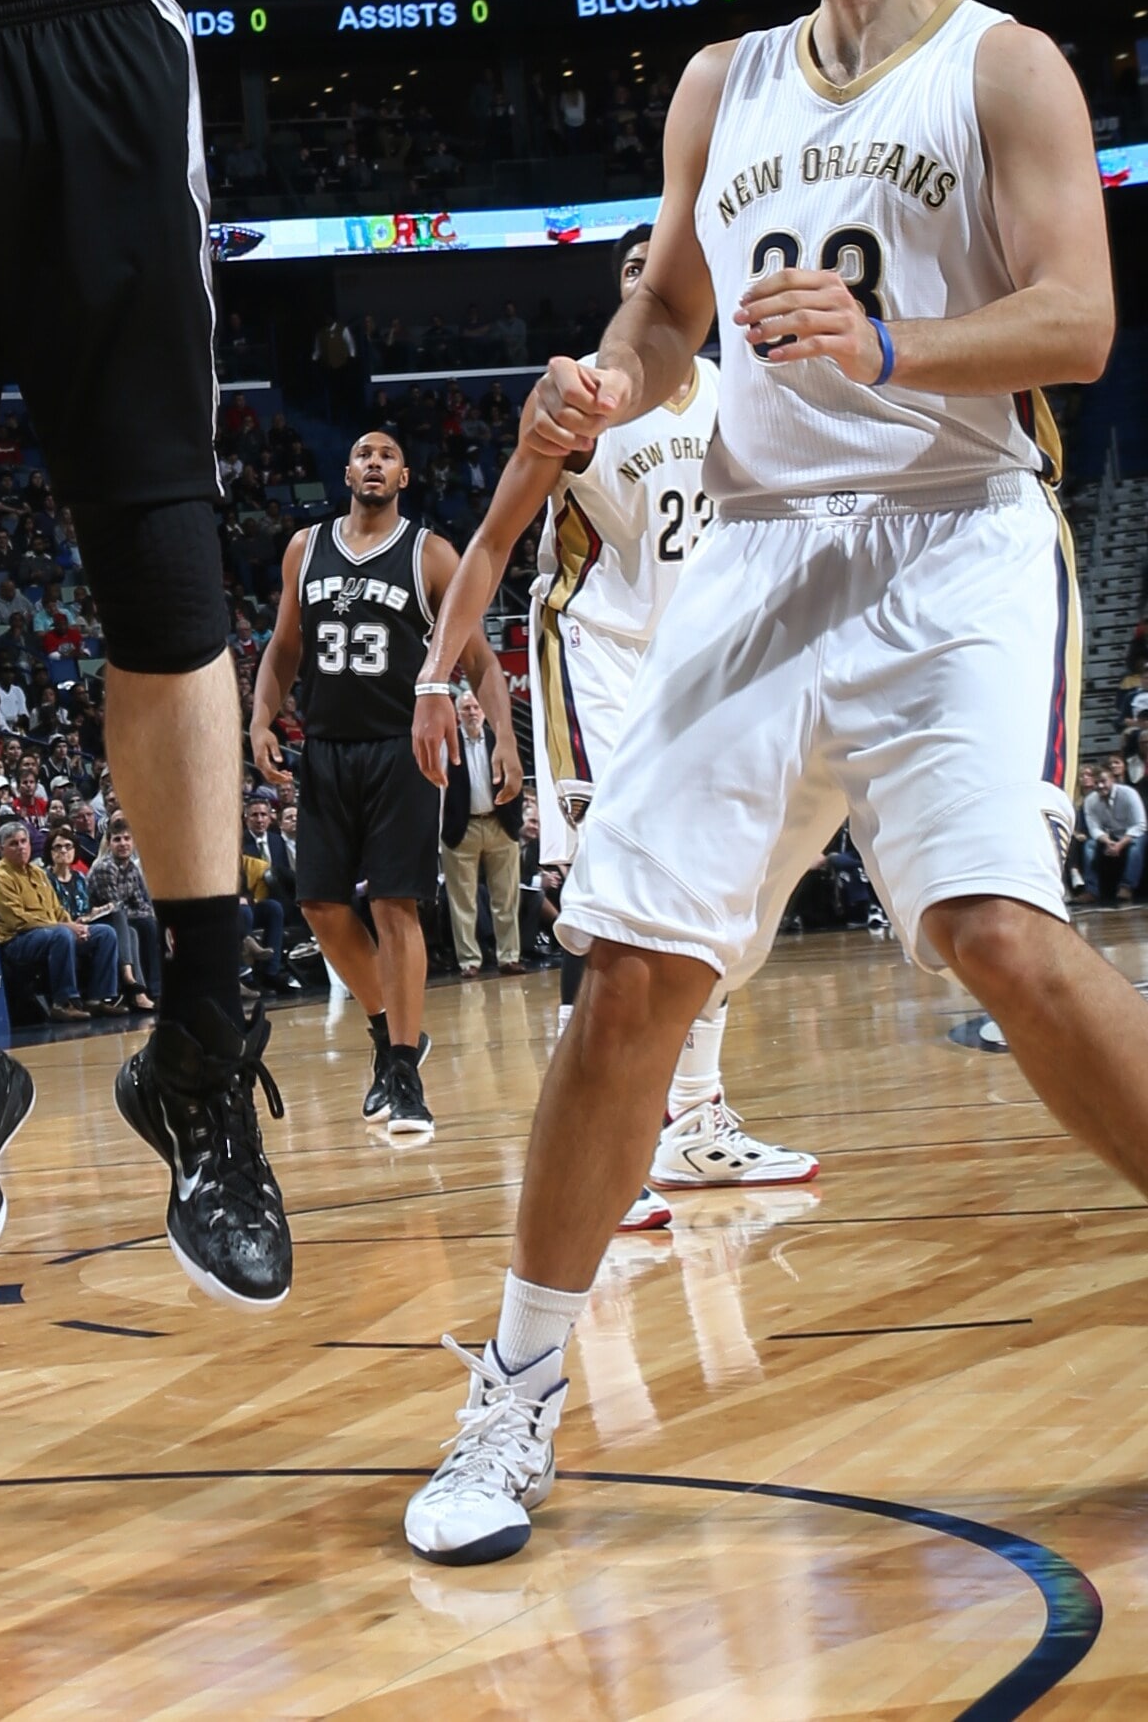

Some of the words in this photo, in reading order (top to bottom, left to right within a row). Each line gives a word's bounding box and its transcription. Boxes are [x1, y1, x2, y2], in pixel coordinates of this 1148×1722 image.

[250, 8, 267, 32] 0
[338, 2, 457, 30] ASSISTS
[471, 0, 489, 24] 0
[717, 150, 783, 229] NEW
[802, 141, 958, 212] ORLEANS
[618, 442, 665, 485] NEW
[670, 435, 713, 461] ORL
[305, 575, 411, 616] SPURS
[316, 620, 390, 677] 33
